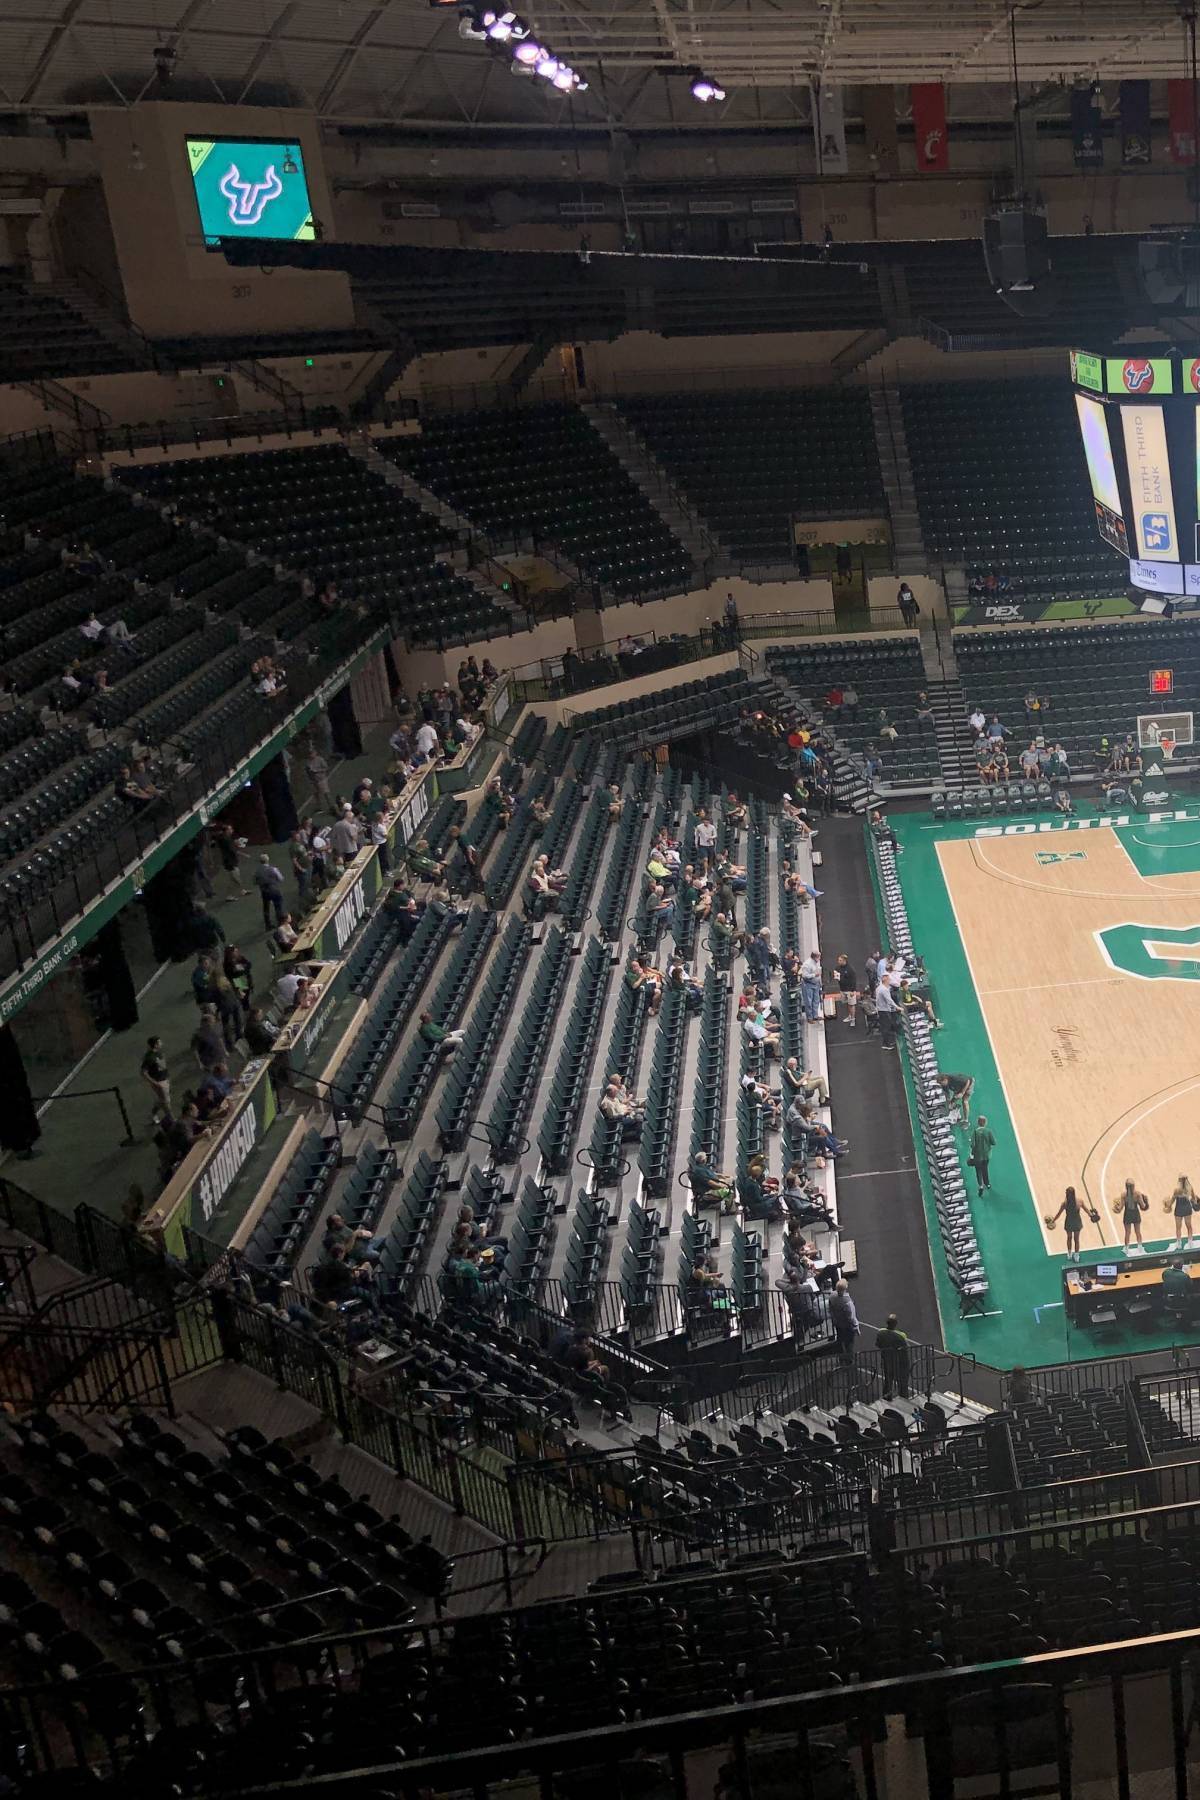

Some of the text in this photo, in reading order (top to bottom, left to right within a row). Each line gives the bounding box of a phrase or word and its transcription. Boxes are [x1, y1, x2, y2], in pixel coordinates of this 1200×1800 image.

[1135, 416, 1153, 503] FIFTH THIRD
[1152, 465, 1163, 503] BANK
[985, 605, 1021, 617] DEX
[975, 816, 1130, 838] SOUTH
[1, 936, 78, 1016] FIFTH THIRD BANK CLUB
[200, 1102, 257, 1221] #HORNSUP
